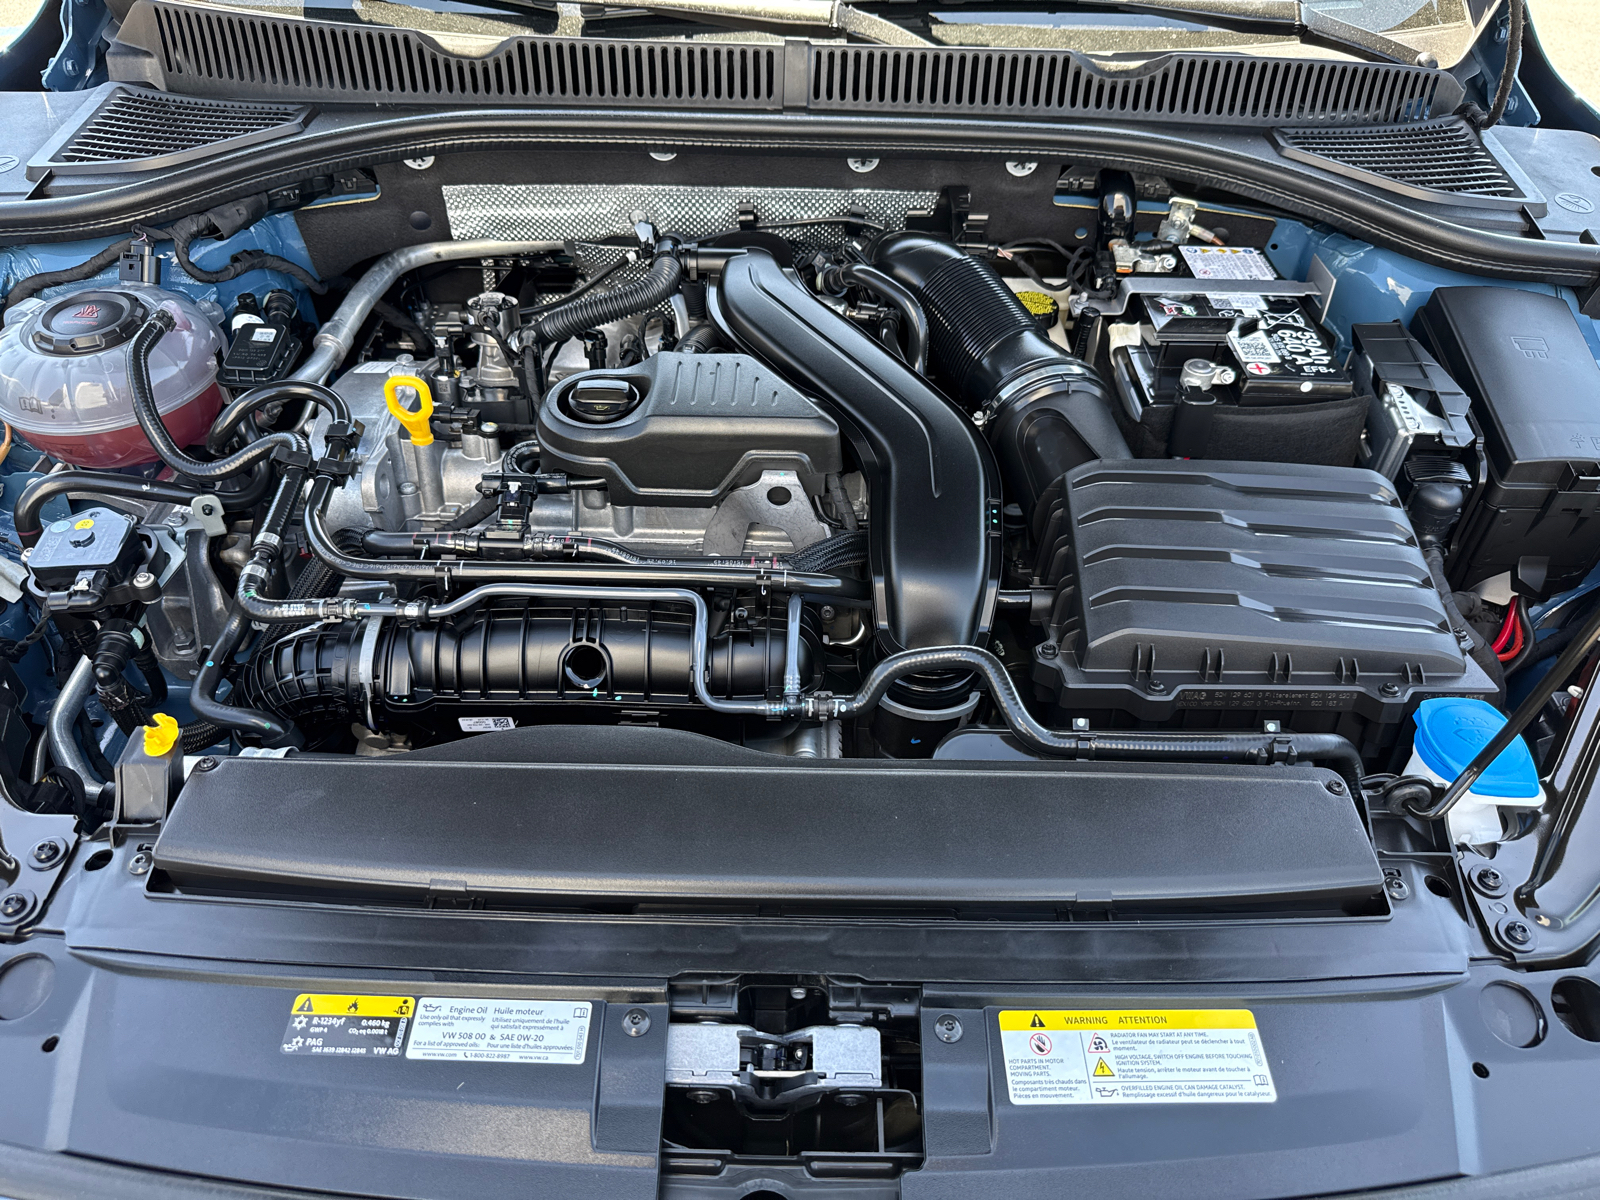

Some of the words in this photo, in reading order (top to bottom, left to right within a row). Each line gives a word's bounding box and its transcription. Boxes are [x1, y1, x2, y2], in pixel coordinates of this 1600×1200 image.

[1278, 330, 1306, 352] 640
[1292, 354, 1314, 365] A
[1297, 331, 1332, 364] 59Ah
[1302, 366, 1336, 374] EFB+
[450, 1006, 475, 1015] Engine
[477, 1006, 488, 1014] Oil
[494, 1007, 514, 1015] Huile
[312, 1016, 346, 1027] R-1234yf
[381, 1020, 390, 1028] kg
[1064, 1016, 1108, 1025] WARNING
[1118, 1016, 1168, 1024] ATTENTION
[442, 1032, 457, 1040] VW
[458, 1032, 474, 1040] 508
[517, 1034, 545, 1042] 0W-20
[306, 1038, 323, 1046] PAG
